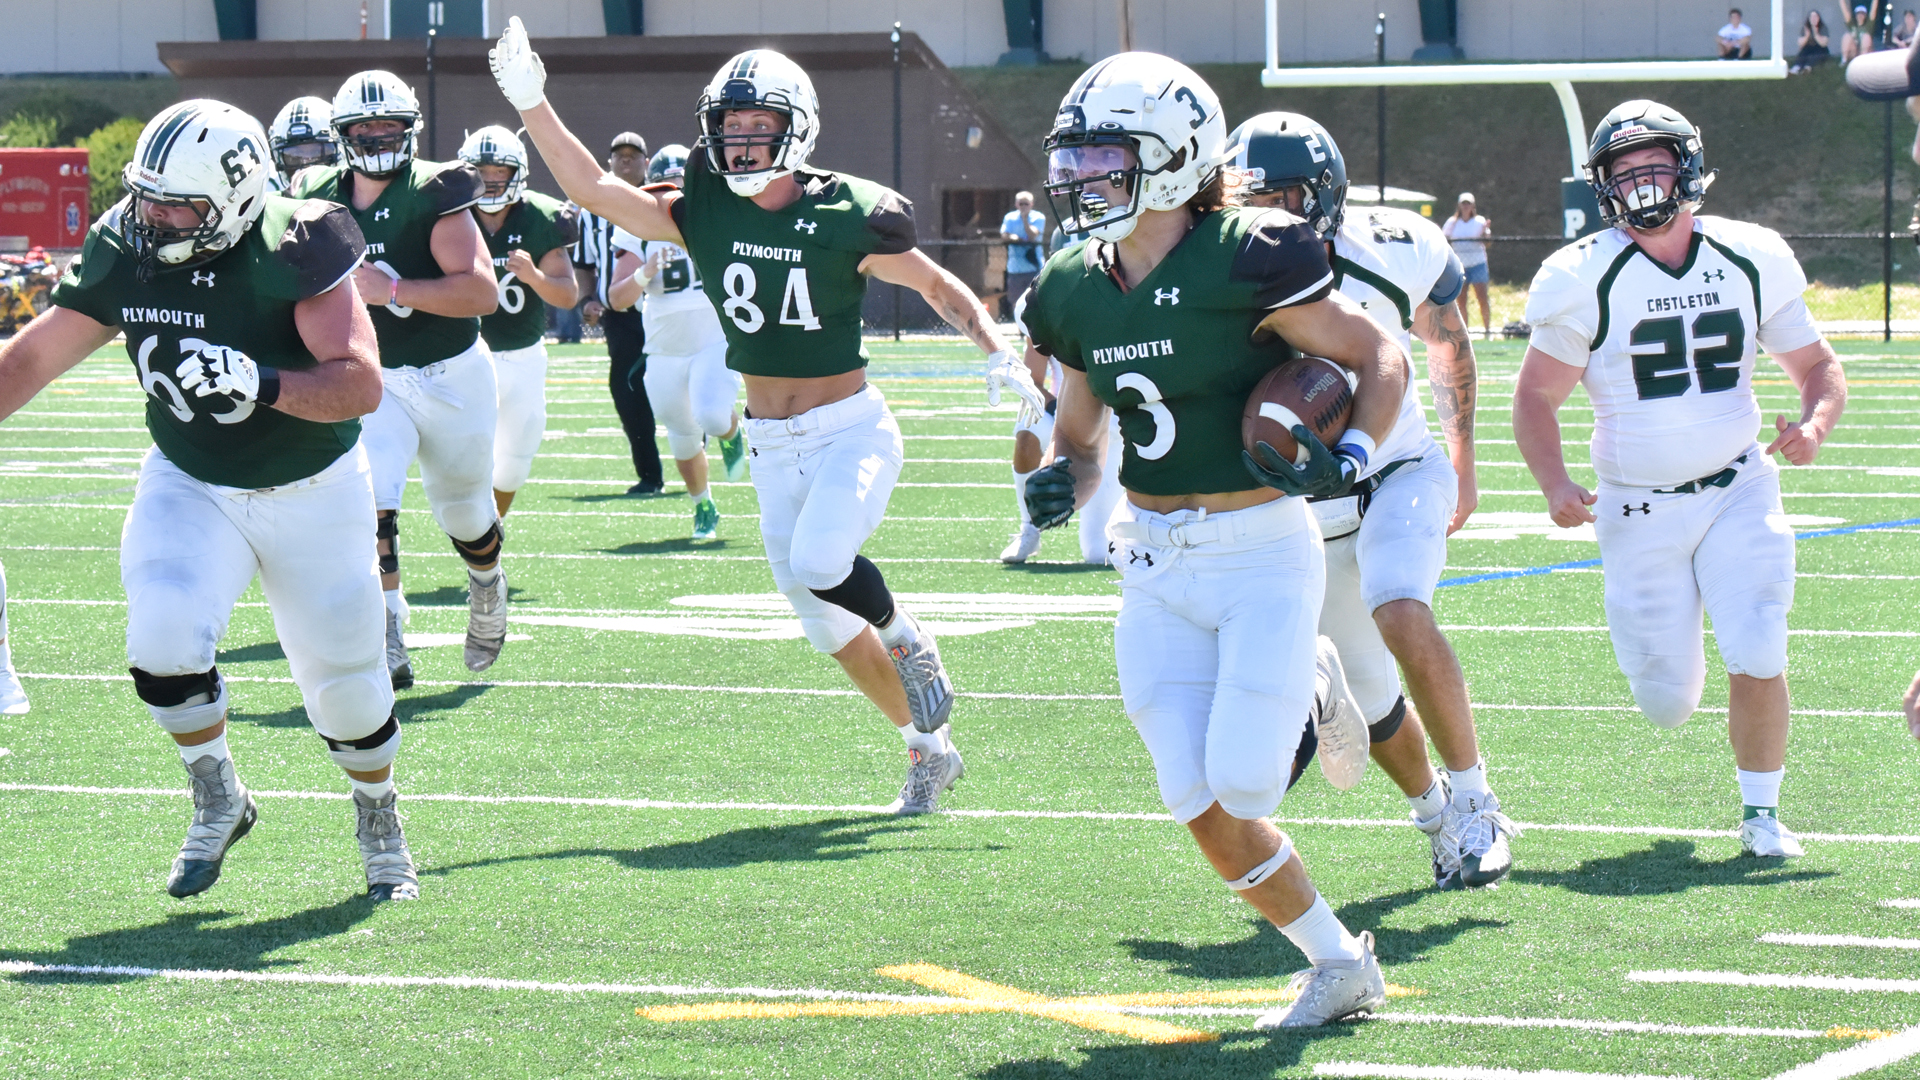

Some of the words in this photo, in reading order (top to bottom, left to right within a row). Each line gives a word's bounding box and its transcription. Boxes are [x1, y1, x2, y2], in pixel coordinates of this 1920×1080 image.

[1175, 86, 1207, 130] 3
[1613, 127, 1643, 138] Riddell
[220, 137, 260, 188] 63
[1564, 208, 1586, 239] P
[732, 241, 802, 262] PLYMOUTH
[722, 262, 823, 334] 84
[1647, 292, 1721, 312] CASTLETON
[122, 307, 206, 328] PLYMOUTH
[1093, 339, 1174, 365] PLYMOUTH
[1629, 307, 1746, 400] 22
[1303, 372, 1338, 403] Wilson
[1115, 372, 1176, 460] 3
